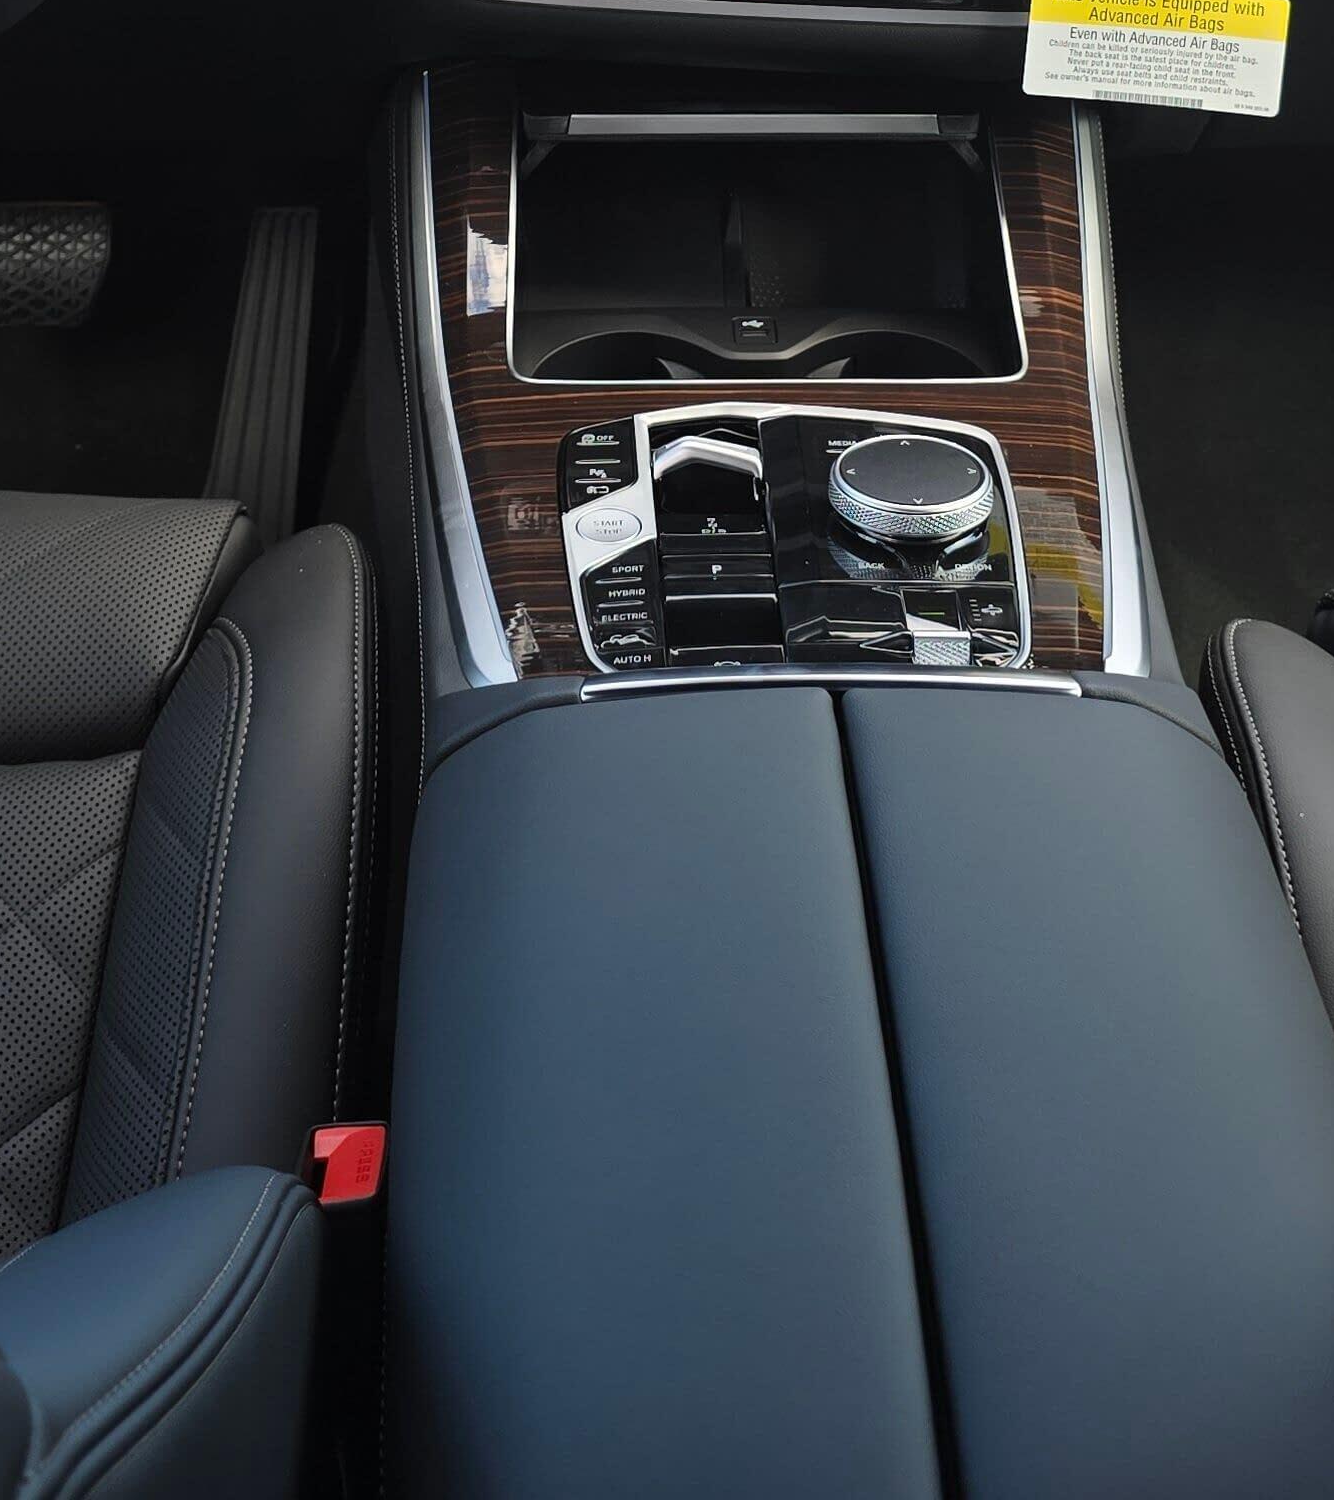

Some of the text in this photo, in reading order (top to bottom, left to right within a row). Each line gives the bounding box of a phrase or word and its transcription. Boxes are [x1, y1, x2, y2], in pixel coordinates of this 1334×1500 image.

[1234, 1, 1265, 16] with
[1088, 7, 1225, 33] Advanced Air Bags
[1070, 26, 1240, 54] Even with Advanced Air Bags
[1049, 39, 1080, 48] Children
[1097, 43, 1107, 51] be
[1109, 44, 1128, 53] killed
[1141, 47, 1174, 57] seriously
[1176, 49, 1203, 59] injured
[1205, 51, 1214, 61] by
[1216, 52, 1228, 61] the
[1230, 54, 1240, 62] air
[1242, 56, 1258, 66] bag.
[1069, 48, 1083, 57] The
[1085, 50, 1102, 59] back
[1105, 52, 1120, 60] seat
[1121, 53, 1129, 61] is
[1130, 54, 1142, 62] the
[1144, 55, 1167, 64] safest
[1168, 57, 1188, 66] place
[1190, 59, 1201, 67] for
[1067, 57, 1089, 65] Never
[1091, 59, 1104, 67] put
[1154, 64, 1172, 73] child
[1174, 66, 1191, 74] seat
[1192, 67, 1200, 75] in
[1201, 68, 1213, 76] the
[1073, 66, 1099, 75] Always
[1116, 70, 1132, 78] seat
[1134, 71, 1152, 79] belts
[1154, 72, 1168, 81] and
[1169, 74, 1188, 82] child
[1045, 72, 1058, 80] See
[1091, 76, 1118, 84] manual
[1120, 77, 1131, 85] for
[1154, 80, 1198, 91] information
[1199, 85, 1221, 94] about
[1223, 88, 1233, 96] air
[611, 564, 645, 573] SPORT
[711, 564, 723, 575] P
[858, 562, 885, 570] BACK
[608, 588, 646, 598] HYBRID
[613, 654, 652, 665] AUTO H
